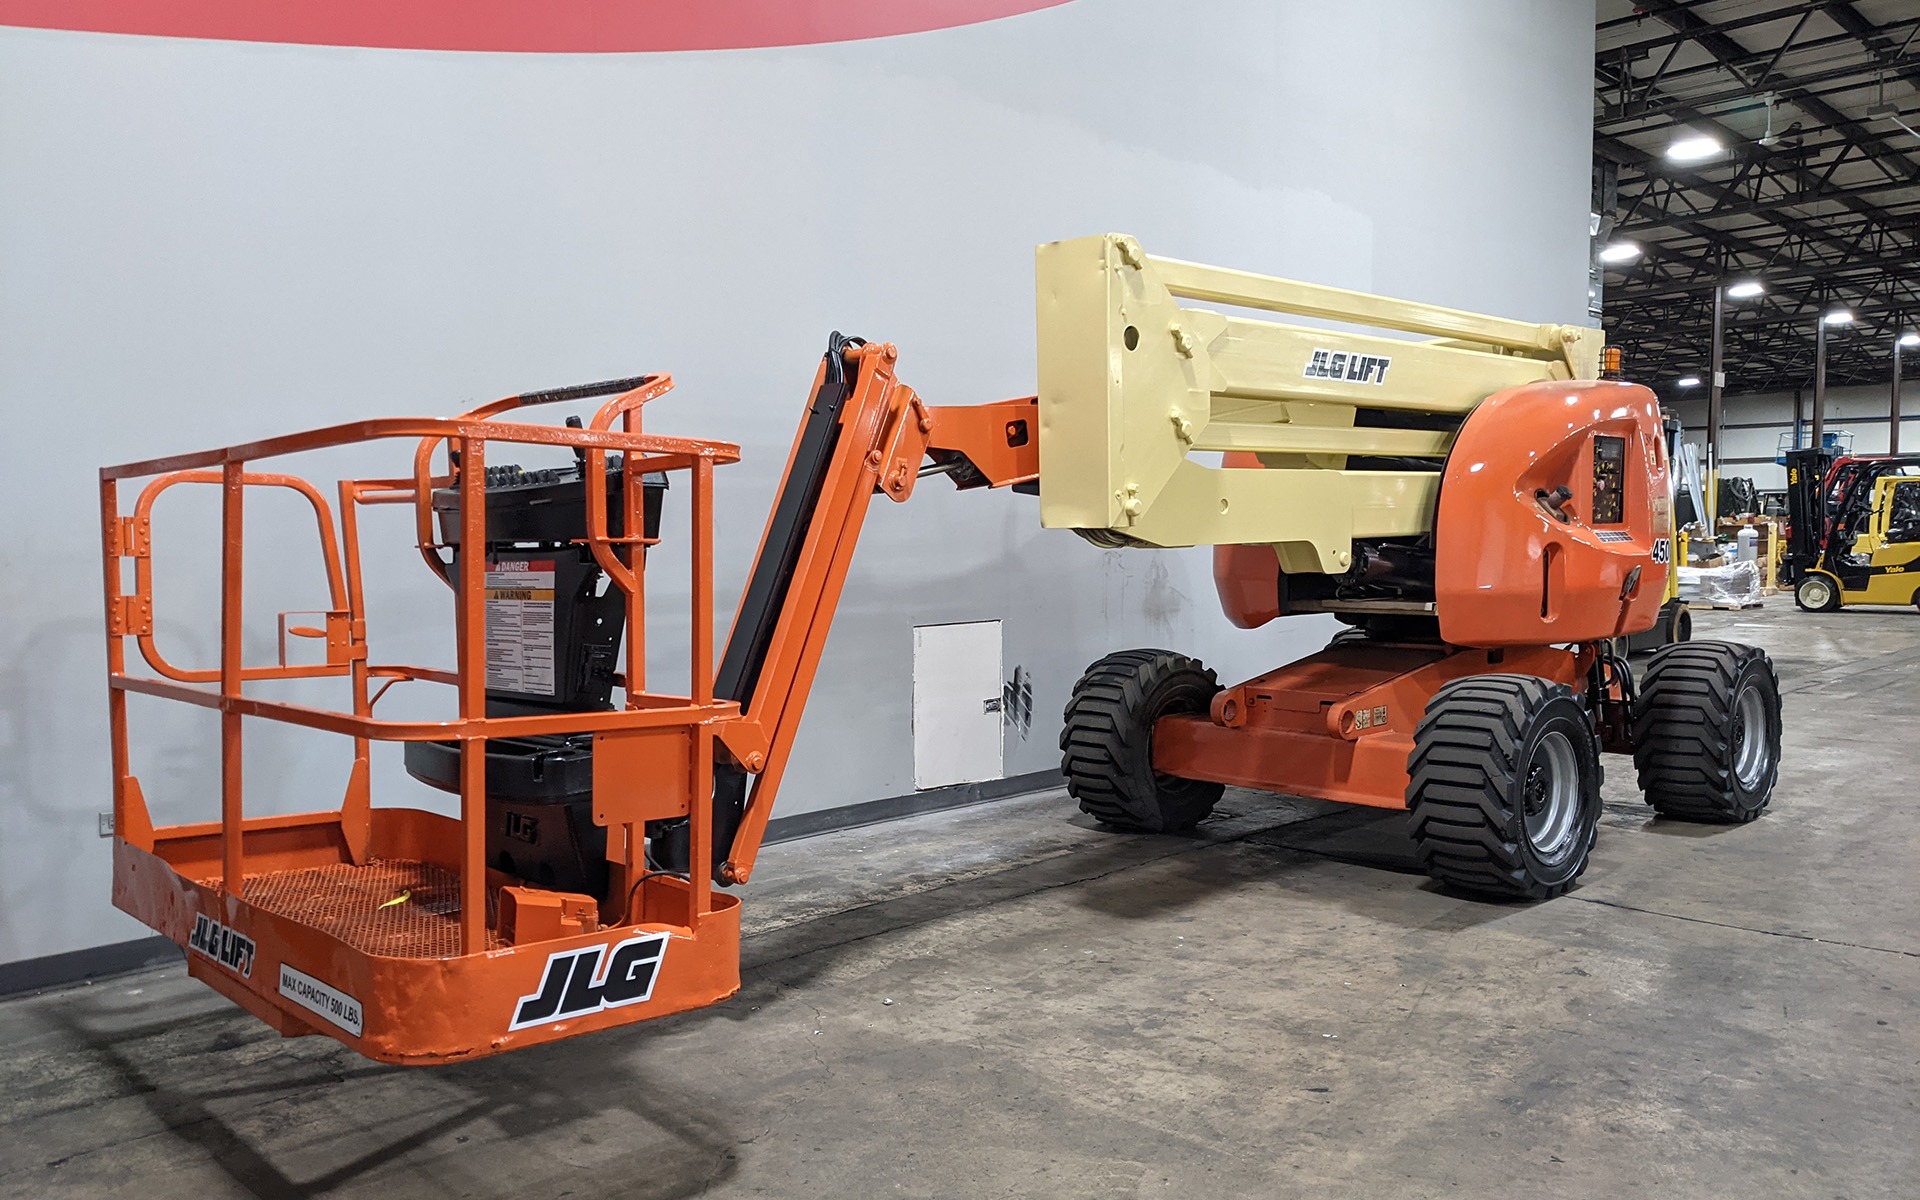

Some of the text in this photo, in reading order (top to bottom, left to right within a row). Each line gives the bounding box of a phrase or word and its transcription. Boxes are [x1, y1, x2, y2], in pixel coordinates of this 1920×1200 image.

[1304, 350, 1390, 383] JLG LIFT
[1652, 539, 1670, 562] 450
[501, 561, 529, 571] DANGER
[1884, 565, 1905, 573] Yale
[500, 590, 531, 600] WARNING
[190, 914, 254, 976] JLG LIFT
[282, 973, 297, 992] MAX
[297, 981, 331, 1009] CAPACITY
[330, 998, 343, 1017] 500
[513, 935, 666, 1027] JLG
